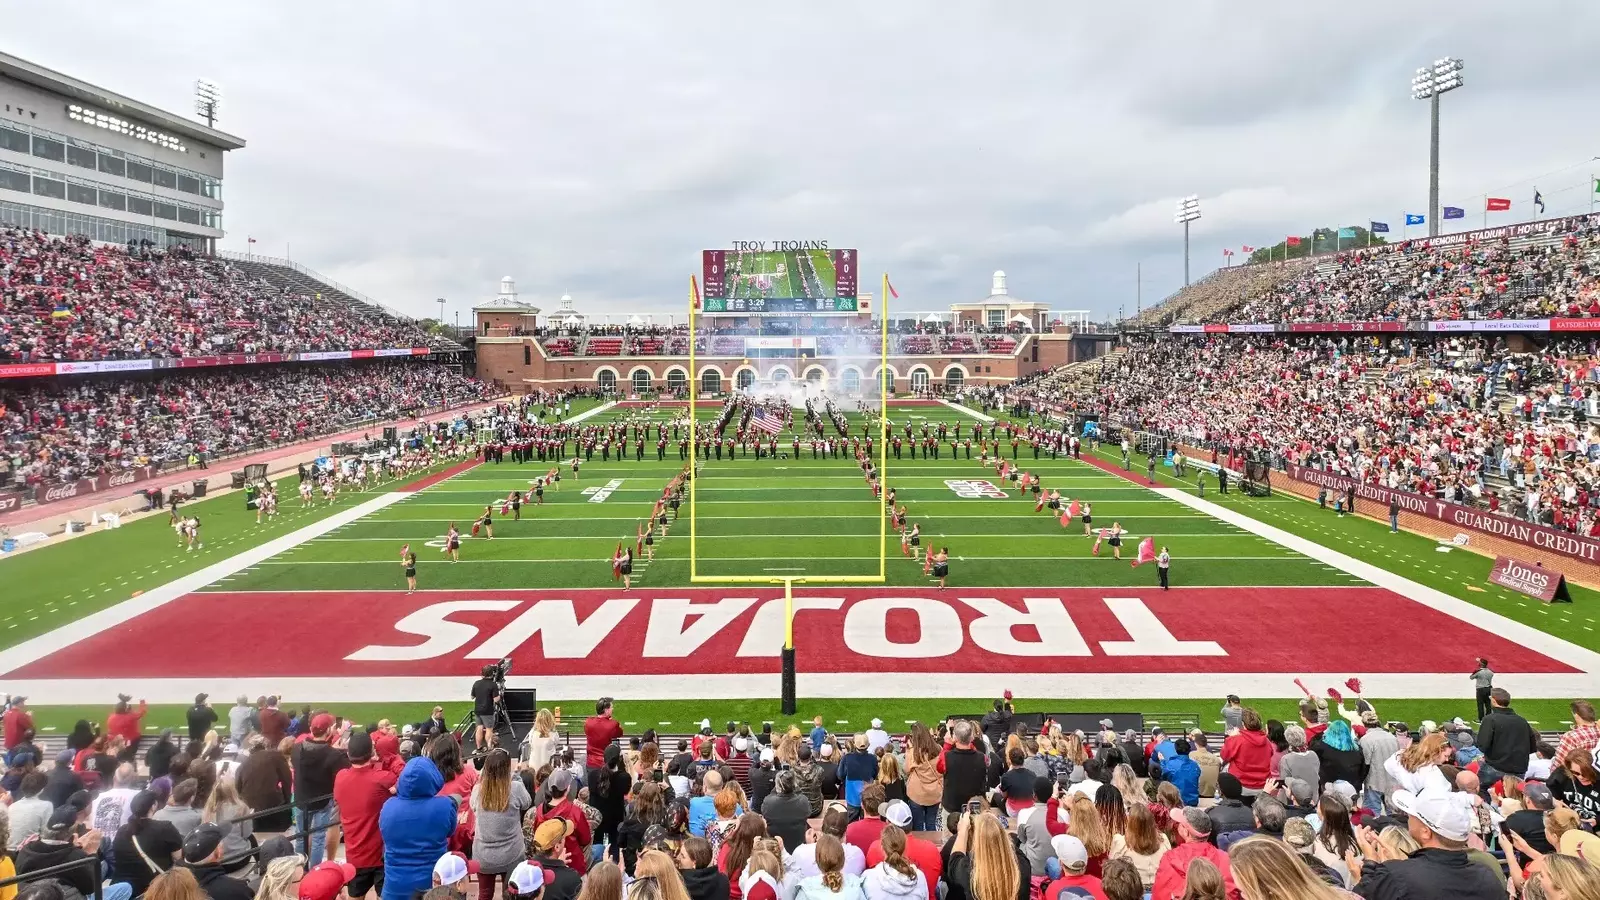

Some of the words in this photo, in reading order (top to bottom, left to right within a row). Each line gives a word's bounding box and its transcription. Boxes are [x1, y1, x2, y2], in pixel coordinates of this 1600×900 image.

[1429, 233, 1467, 246] MEMORIAL
[1469, 228, 1506, 241] STADIUM
[732, 240, 766, 251] TROY
[772, 239, 828, 252] TROJANS
[712, 264, 718, 274] 0
[843, 263, 849, 273] 0
[748, 298, 765, 306] 3:26
[1351, 323, 1364, 331] 3:26
[245, 355, 257, 364] 3:26
[1304, 470, 1351, 492] GUARDIAN
[1454, 509, 1532, 542] GUARDIAN
[1533, 530, 1599, 560] CREDIT
[1502, 559, 1549, 587] Jones
[1498, 575, 1522, 589] Medical
[1521, 580, 1544, 597] Supply
[342, 597, 1229, 661] TROJANS
